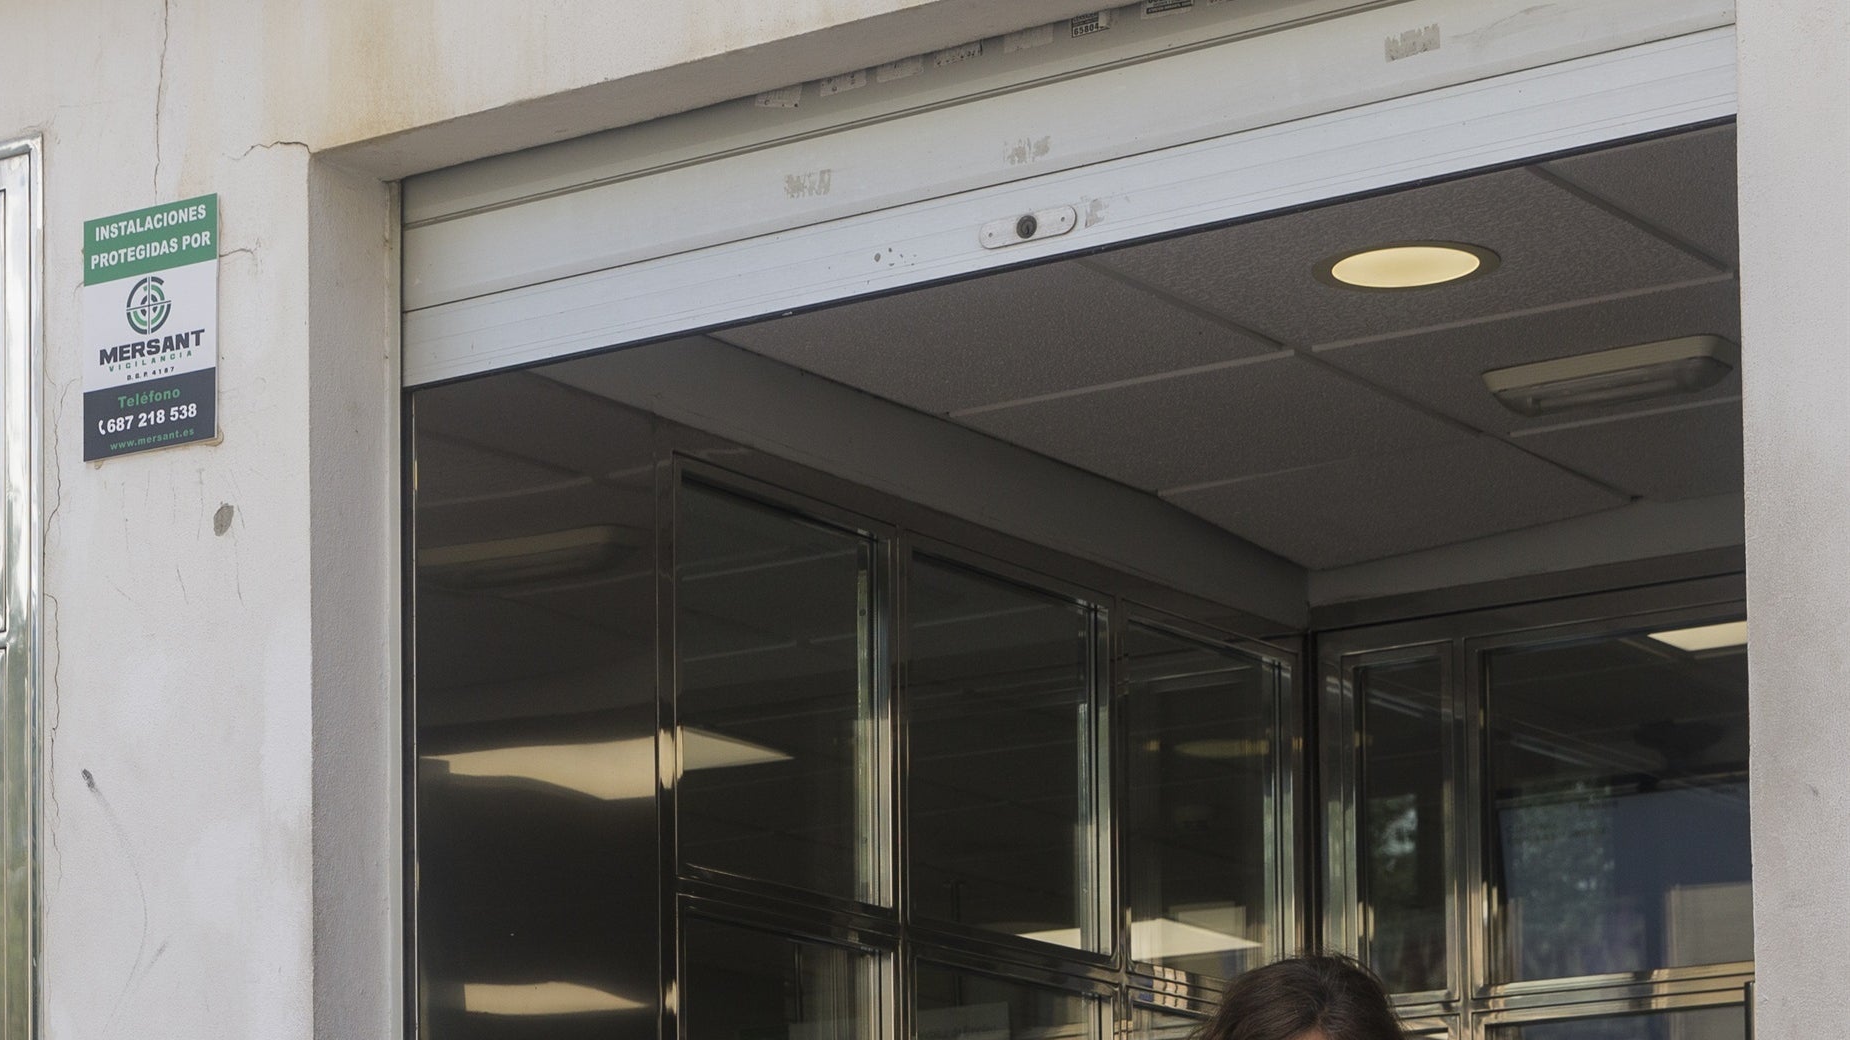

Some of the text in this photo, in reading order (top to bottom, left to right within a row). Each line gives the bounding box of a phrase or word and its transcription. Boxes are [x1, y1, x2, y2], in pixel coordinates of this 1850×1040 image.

[95, 204, 206, 242] INSTALACIONES
[90, 230, 211, 270] PROTEGIDAS POR
[99, 328, 206, 366] MERSANT
[108, 350, 192, 373] VIGILANCIA
[117, 388, 181, 409] Teléfono
[106, 403, 197, 433] 687 218 538
[109, 428, 195, 450] www.mersant.es
